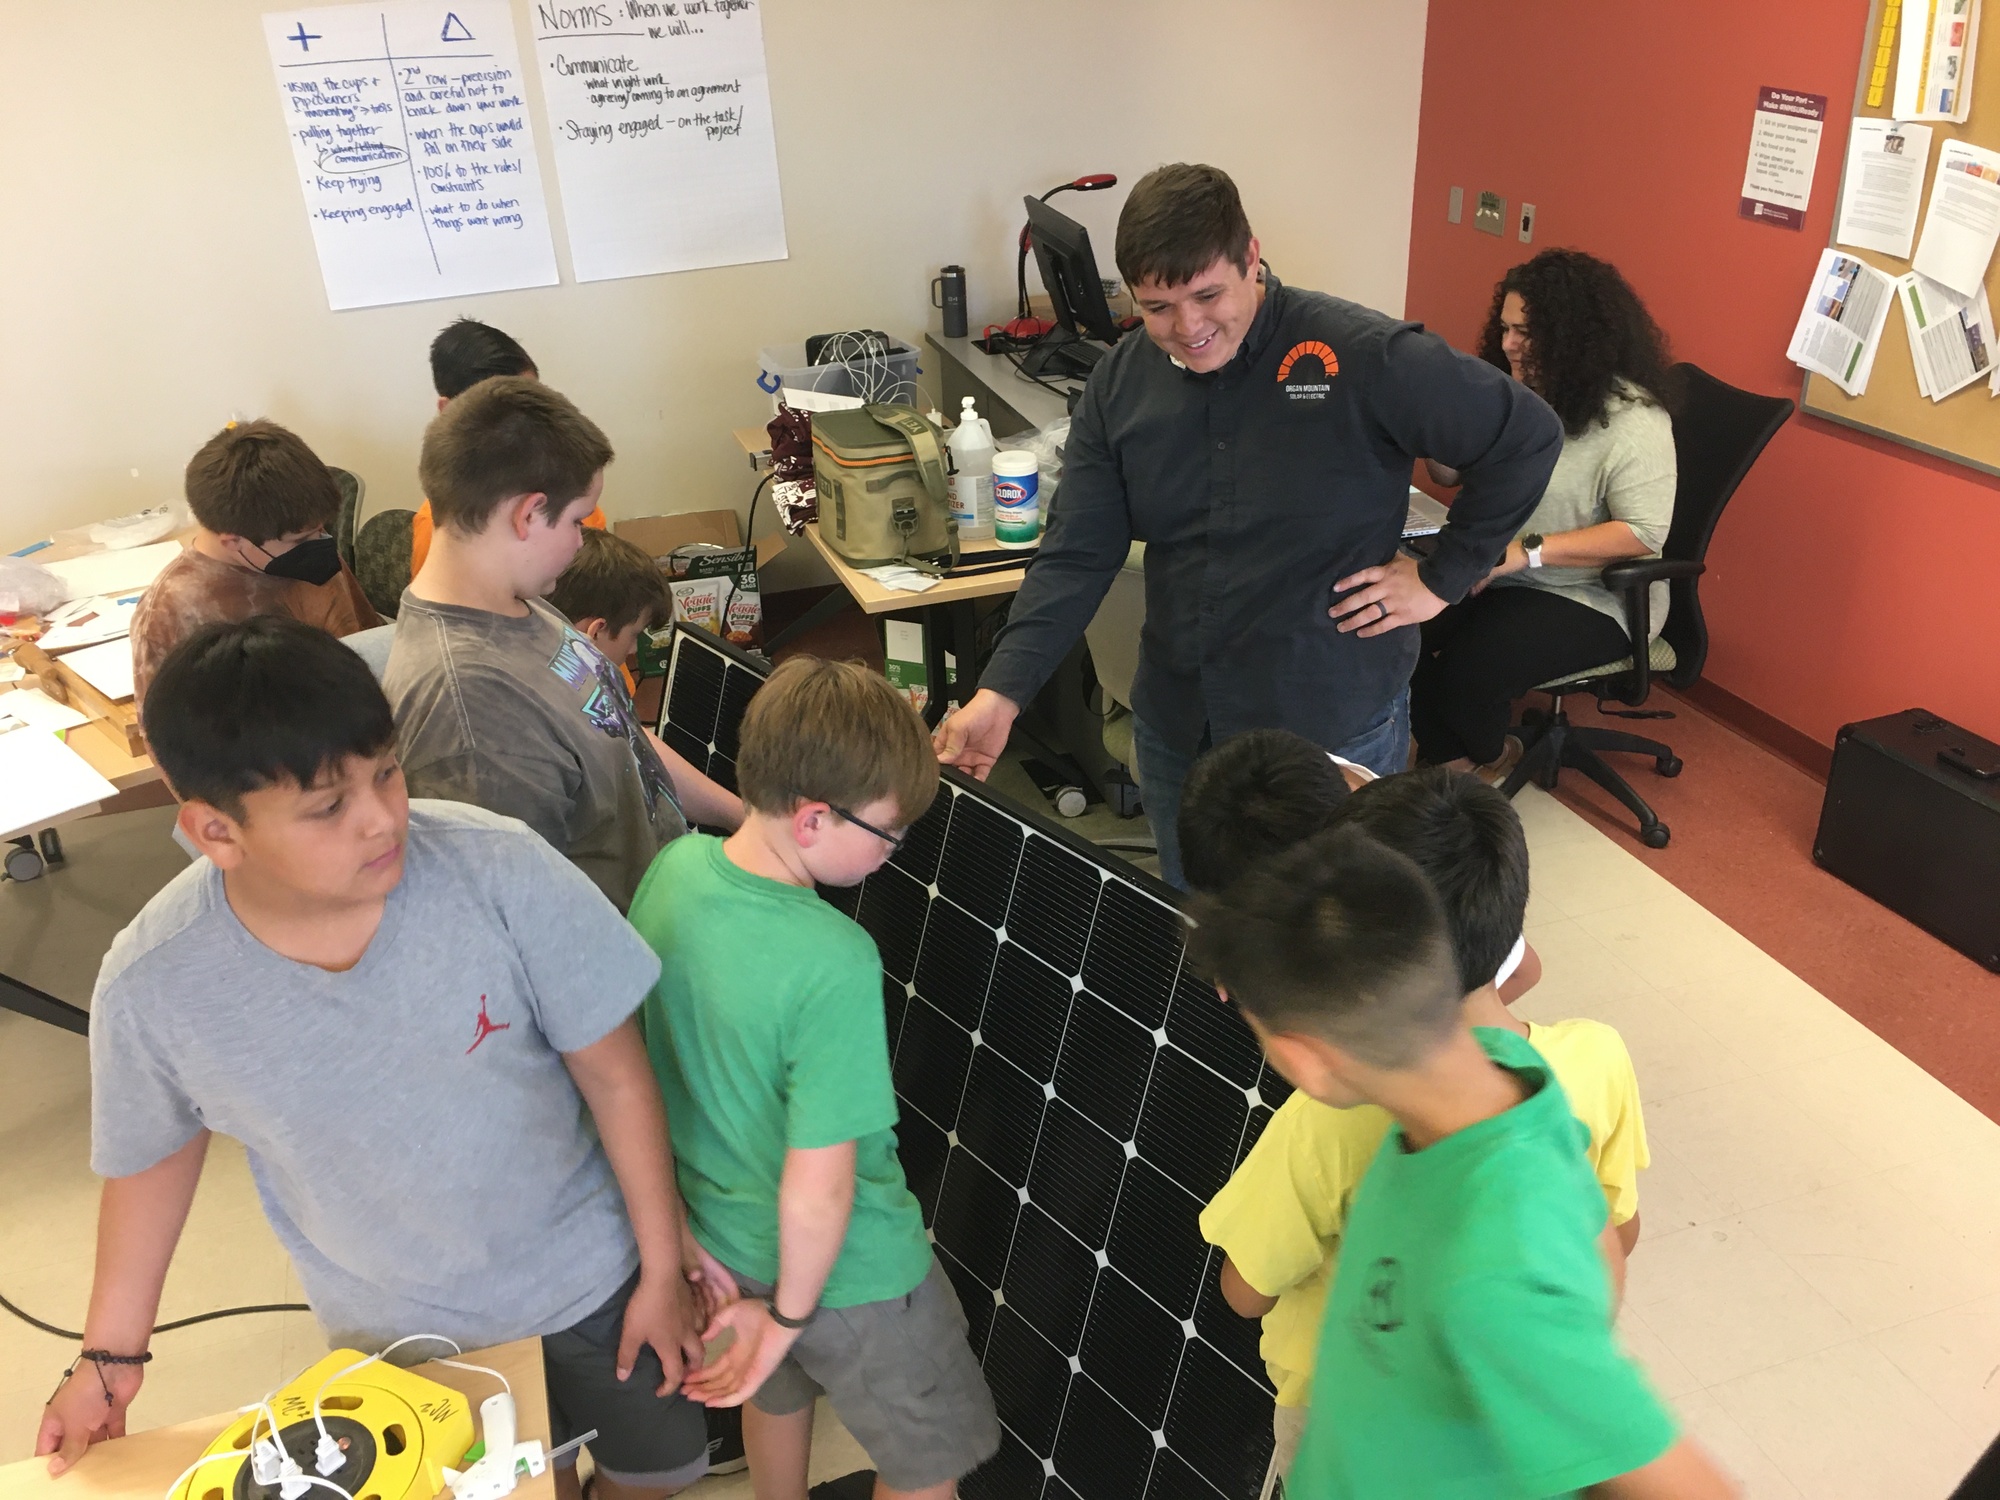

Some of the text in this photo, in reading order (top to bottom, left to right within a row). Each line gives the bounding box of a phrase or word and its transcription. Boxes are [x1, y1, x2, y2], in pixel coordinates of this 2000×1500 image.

[663, 2, 680, 17] we
[648, 26, 667, 39] we
[556, 54, 639, 76] Communicate
[323, 77, 340, 90] the
[341, 77, 368, 93] cups
[425, 74, 448, 85] row
[404, 90, 426, 102] and
[467, 84, 488, 96] not
[492, 83, 504, 94] to
[665, 88, 675, 99] to
[677, 87, 690, 98] an
[1771, 91, 1780, 99] Do
[1781, 93, 1795, 101] Your
[336, 124, 383, 143] together
[449, 121, 467, 137] the
[566, 119, 613, 144] Staying
[618, 114, 664, 139] engaged
[678, 116, 692, 127] on
[693, 113, 712, 126] the
[706, 122, 742, 141] project
[491, 135, 513, 148] side
[471, 161, 492, 176] the
[316, 173, 382, 193] Keep trying
[320, 198, 414, 223] Keeping engaged
[429, 198, 520, 215] what to do when
[492, 213, 524, 230] wrong
[1303, 384, 1330, 392] MOUNTAIN
[996, 487, 1022, 499] CLOROX
[740, 574, 756, 585] 36
[678, 595, 716, 610] Veggie
[687, 605, 711, 614] PUFFS
